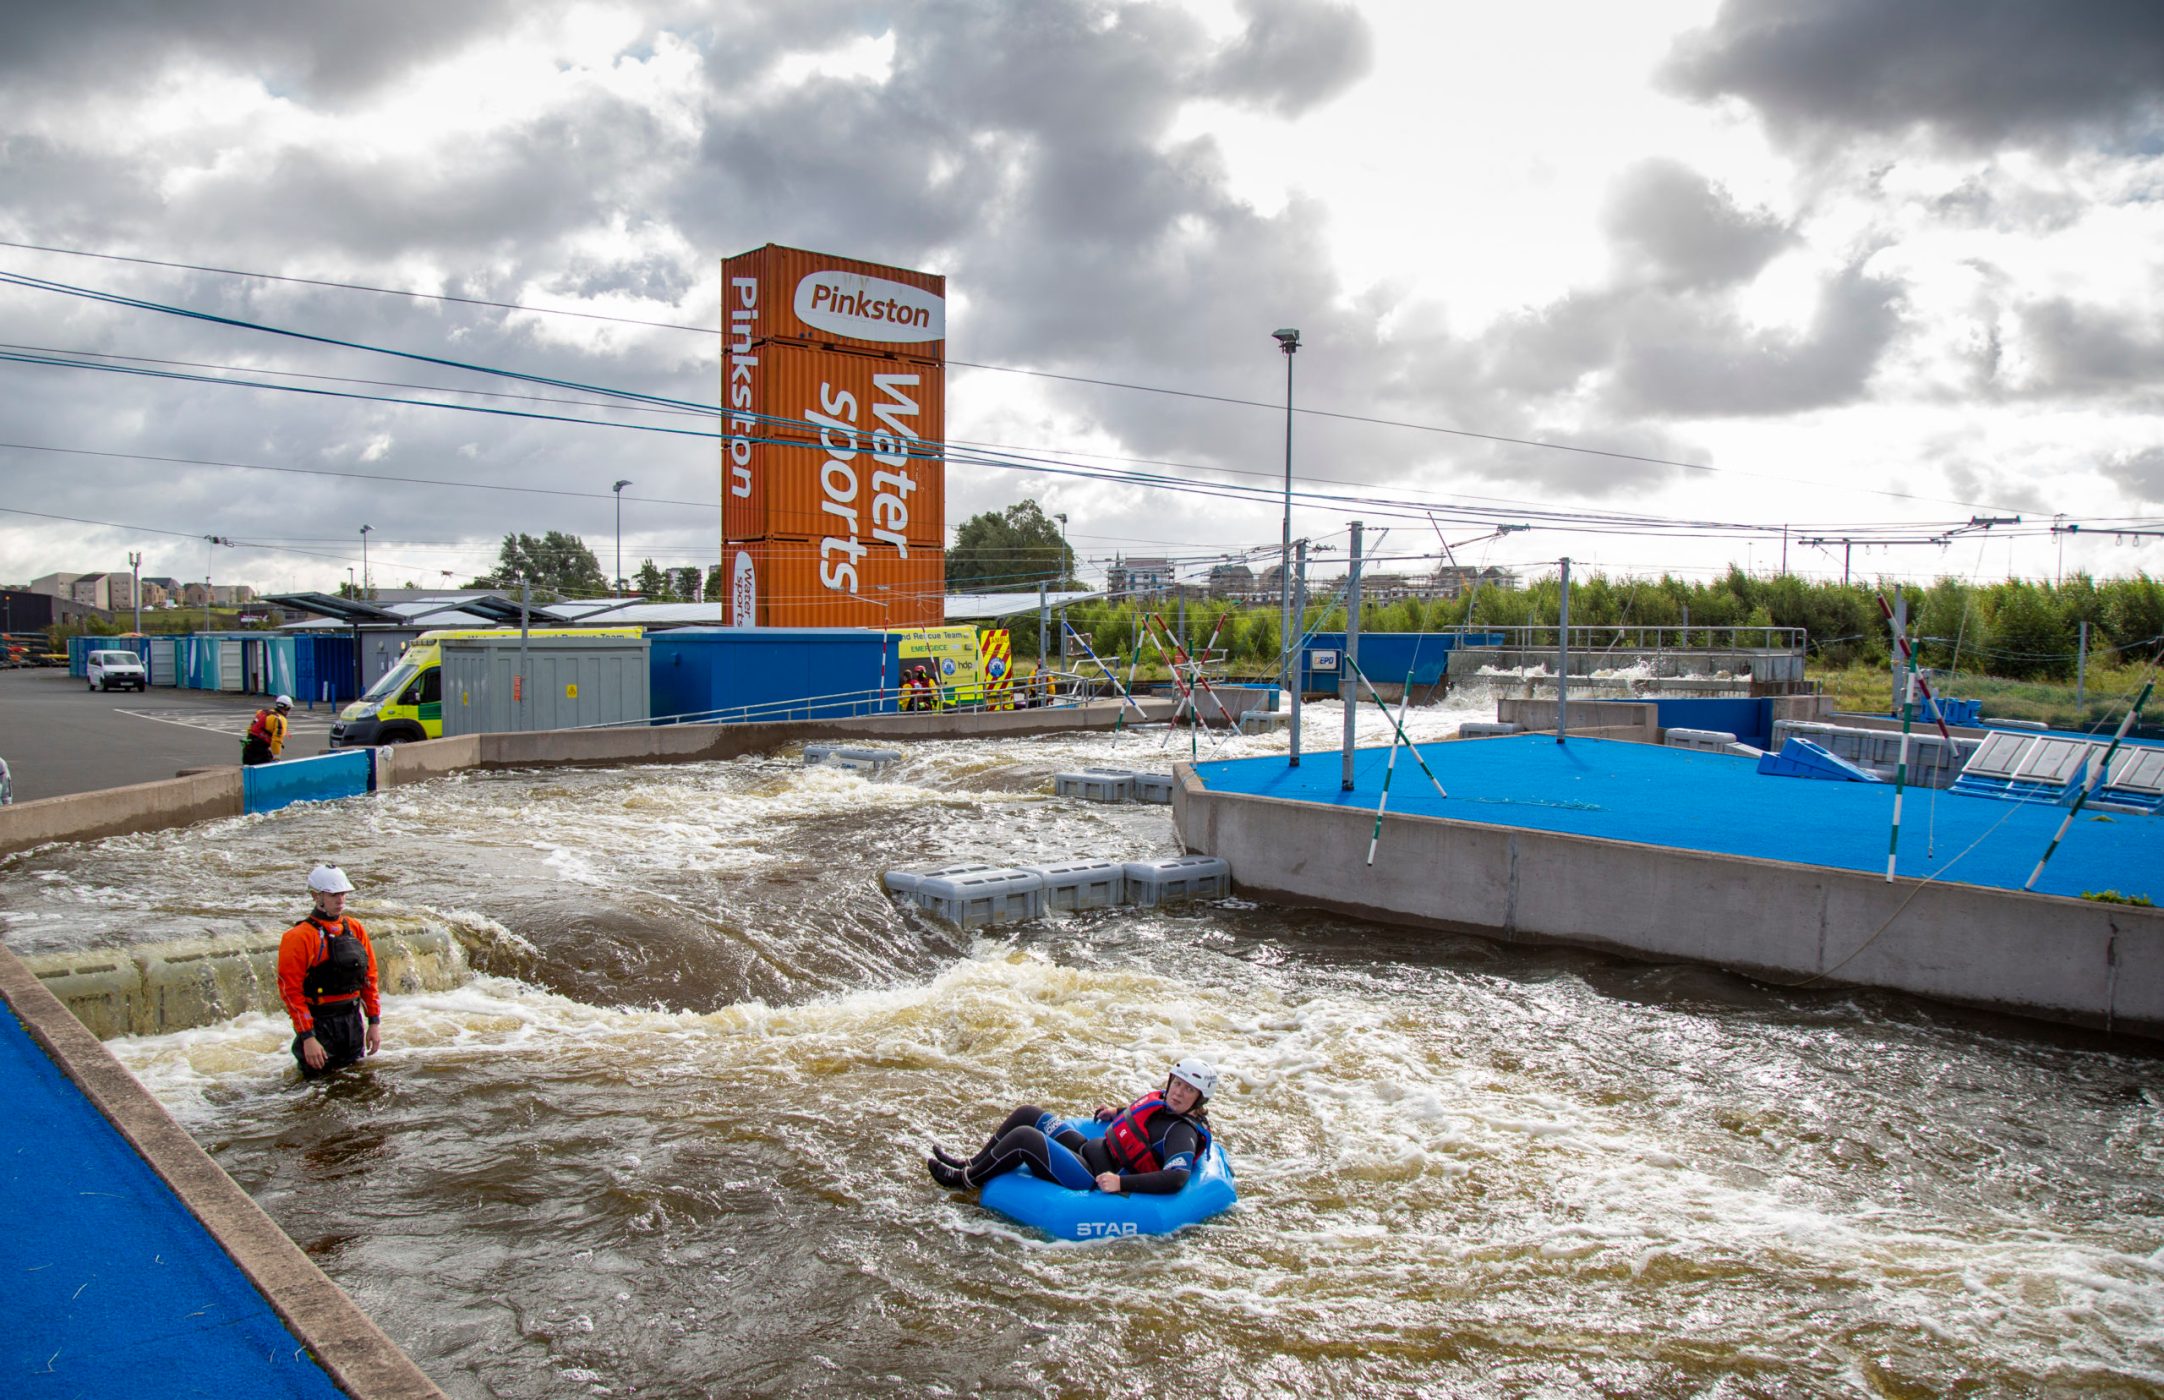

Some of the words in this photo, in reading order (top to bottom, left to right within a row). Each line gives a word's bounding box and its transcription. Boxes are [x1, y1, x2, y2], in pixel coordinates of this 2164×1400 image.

[811, 283, 930, 328] Pinkston
[732, 277, 759, 499] Pinkston
[805, 381, 868, 594] sports
[872, 373, 920, 559] Water
[735, 575, 744, 628] sports
[744, 567, 752, 619] Water
[913, 632, 941, 640] Recue
[943, 631, 962, 639] Team
[1076, 1222, 1138, 1236] STAR
